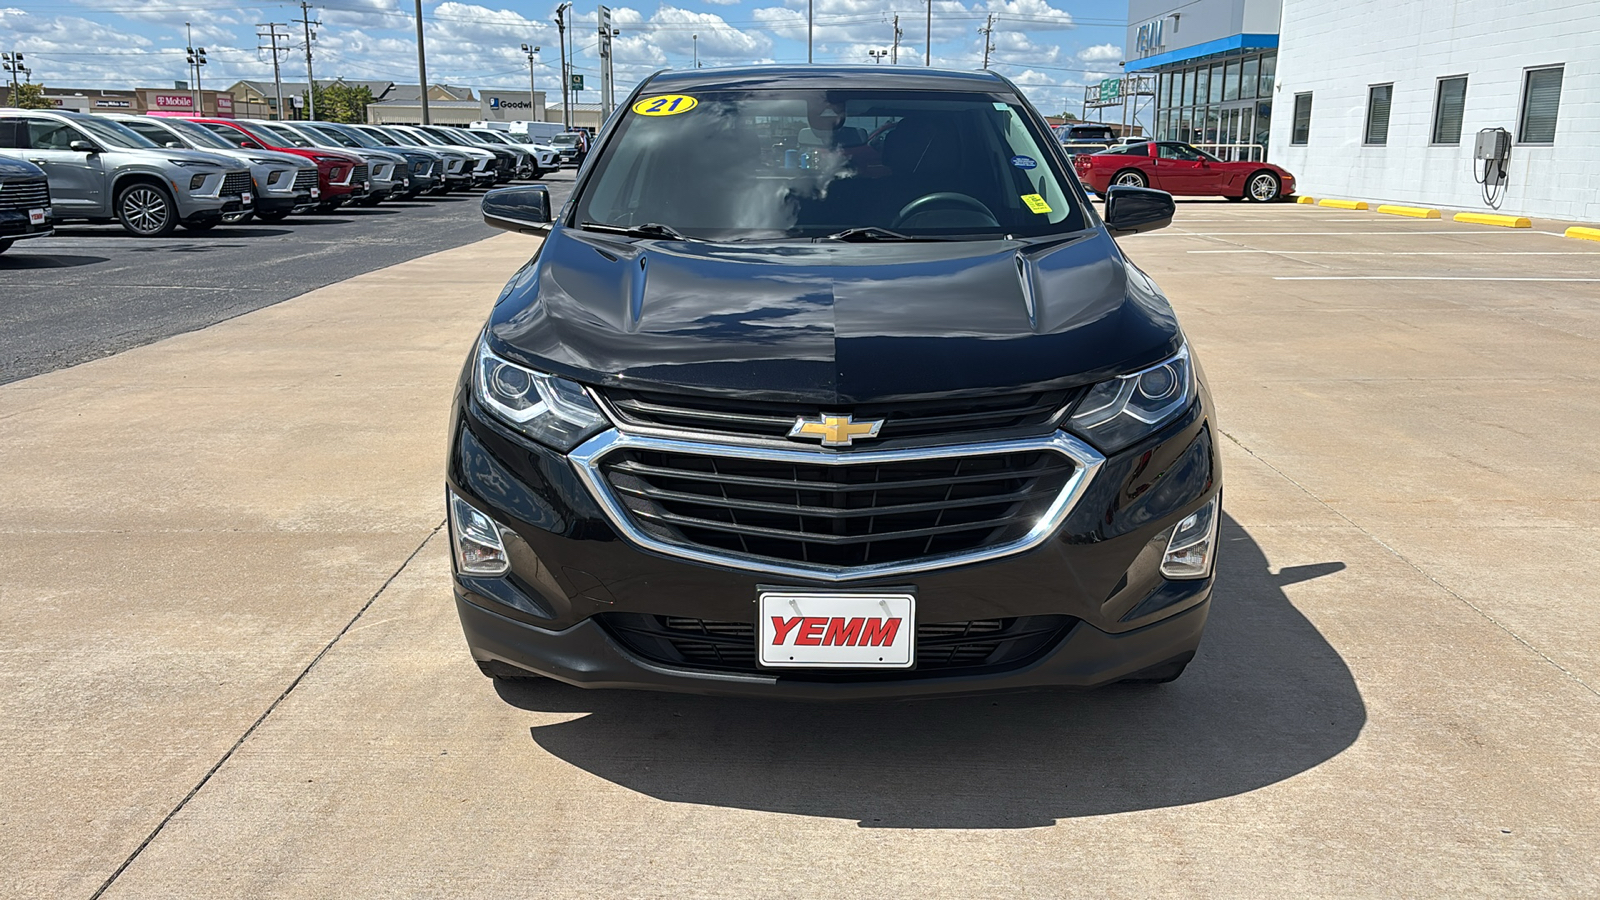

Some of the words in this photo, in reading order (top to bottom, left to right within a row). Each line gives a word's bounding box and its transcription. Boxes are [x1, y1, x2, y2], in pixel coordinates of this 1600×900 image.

[165, 97, 191, 106] Mobile
[500, 100, 532, 109] Goodwi
[645, 97, 683, 113] 21
[770, 615, 903, 647] YEMM
